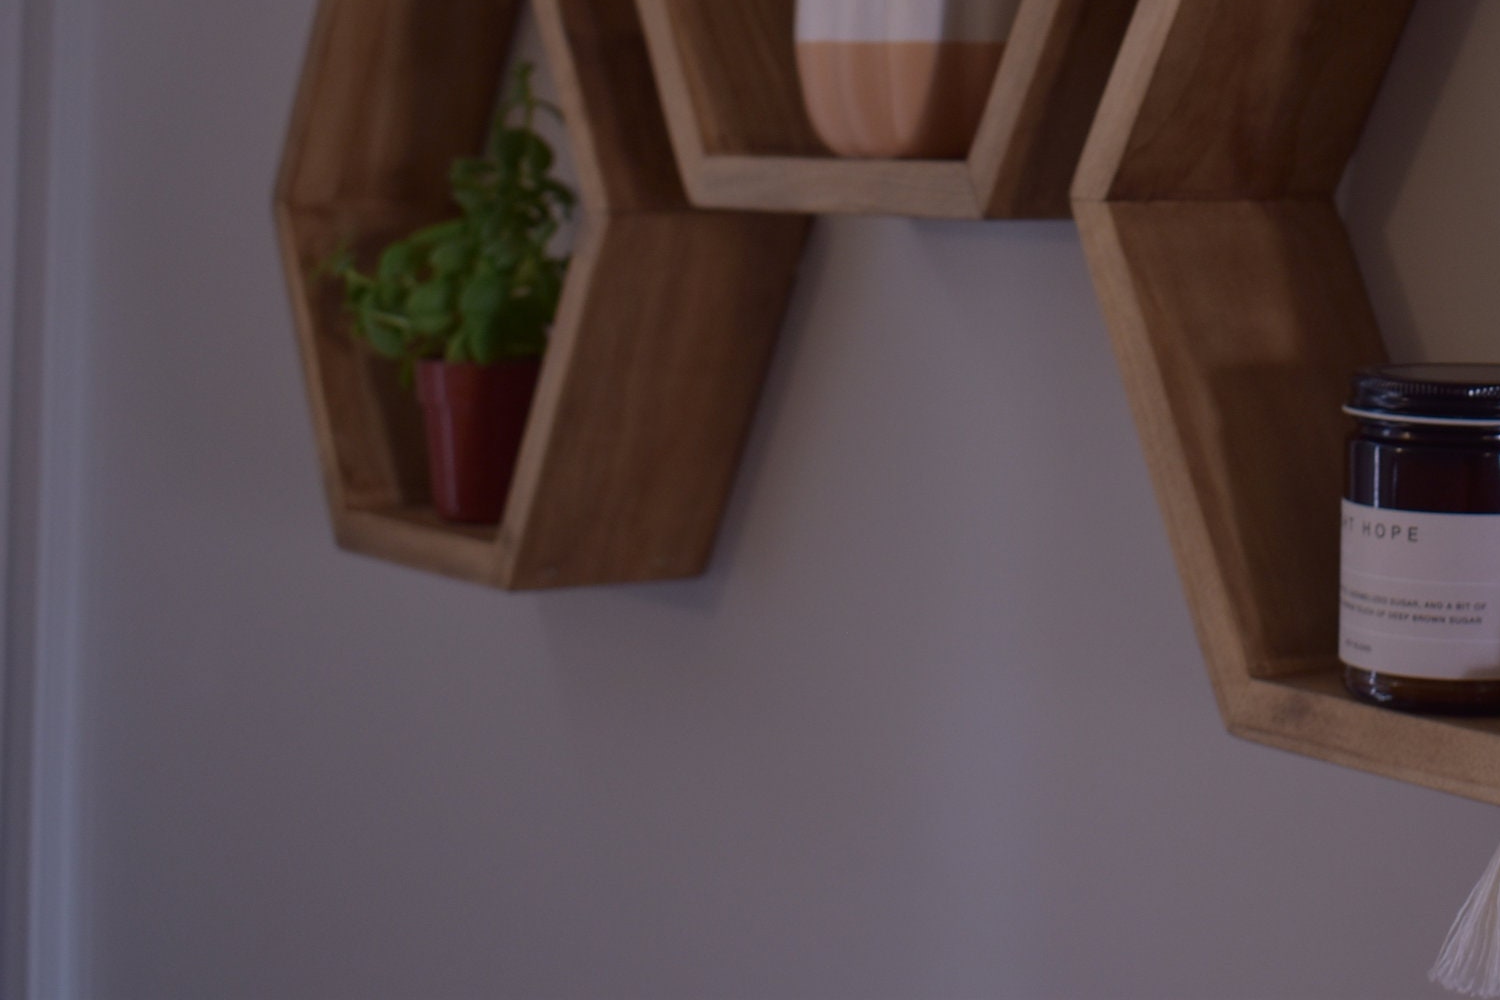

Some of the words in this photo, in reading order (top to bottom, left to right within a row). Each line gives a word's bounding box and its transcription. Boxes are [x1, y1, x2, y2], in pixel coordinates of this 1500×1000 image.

[1362, 520, 1418, 542] HOPE
[1424, 601, 1443, 610] AND
[1456, 601, 1470, 610] BIT
[1473, 601, 1487, 611] OF
[1412, 614, 1445, 624] BROWN
[1449, 616, 1483, 625] SUGAR
